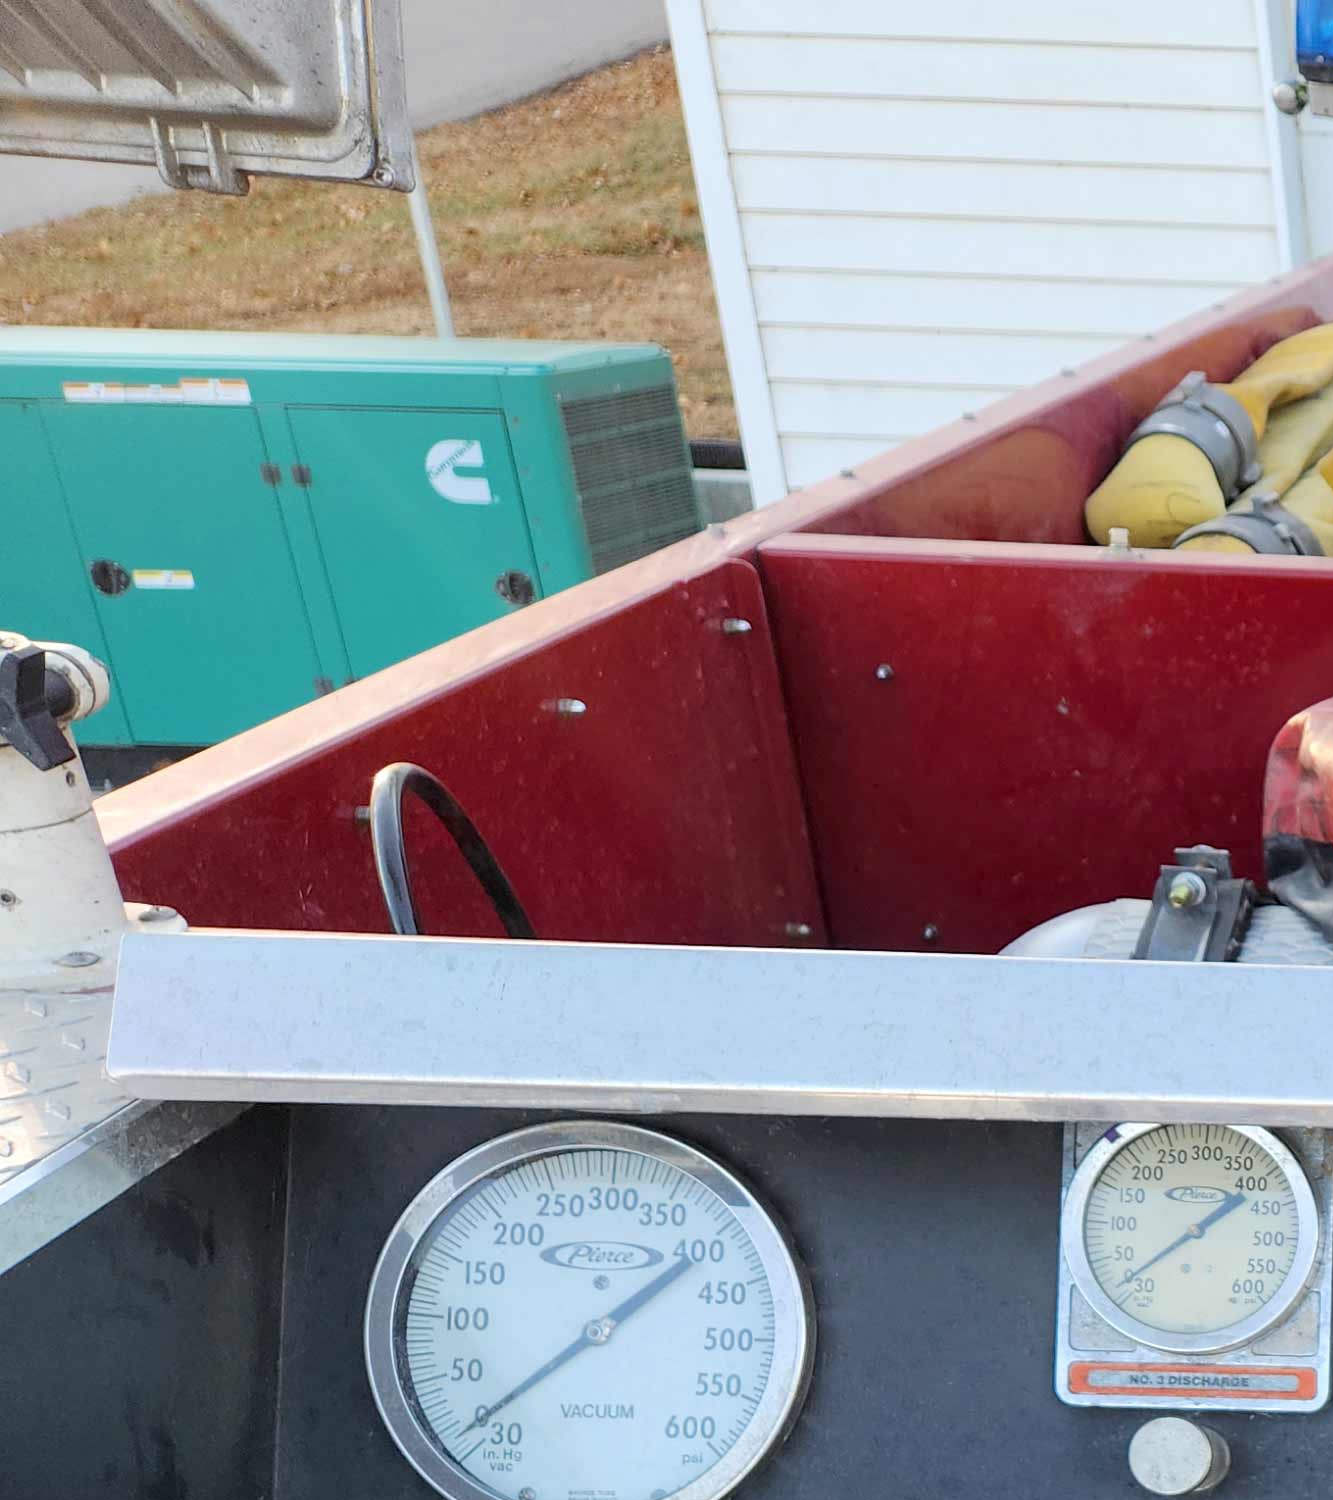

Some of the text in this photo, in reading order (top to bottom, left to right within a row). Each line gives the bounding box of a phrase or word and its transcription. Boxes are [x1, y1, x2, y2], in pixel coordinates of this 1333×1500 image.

[536, 1194, 584, 1218] 250
[588, 1188, 639, 1211] 300
[639, 1204, 686, 1226] 350
[494, 1223, 544, 1247] 200
[567, 1244, 635, 1265] Pierce
[672, 1240, 724, 1263] 400
[464, 1262, 505, 1285] 150
[698, 1282, 746, 1304] 450
[446, 1308, 489, 1330] 100
[704, 1329, 753, 1351] 500
[450, 1359, 483, 1382] 50
[1129, 1375, 1153, 1385] NO.
[1167, 1375, 1249, 1387] DISCHARGE
[695, 1374, 742, 1396] 550
[560, 1404, 634, 1420] VACUUM
[489, 1423, 522, 1445] 30
[665, 1416, 715, 1439] 600
